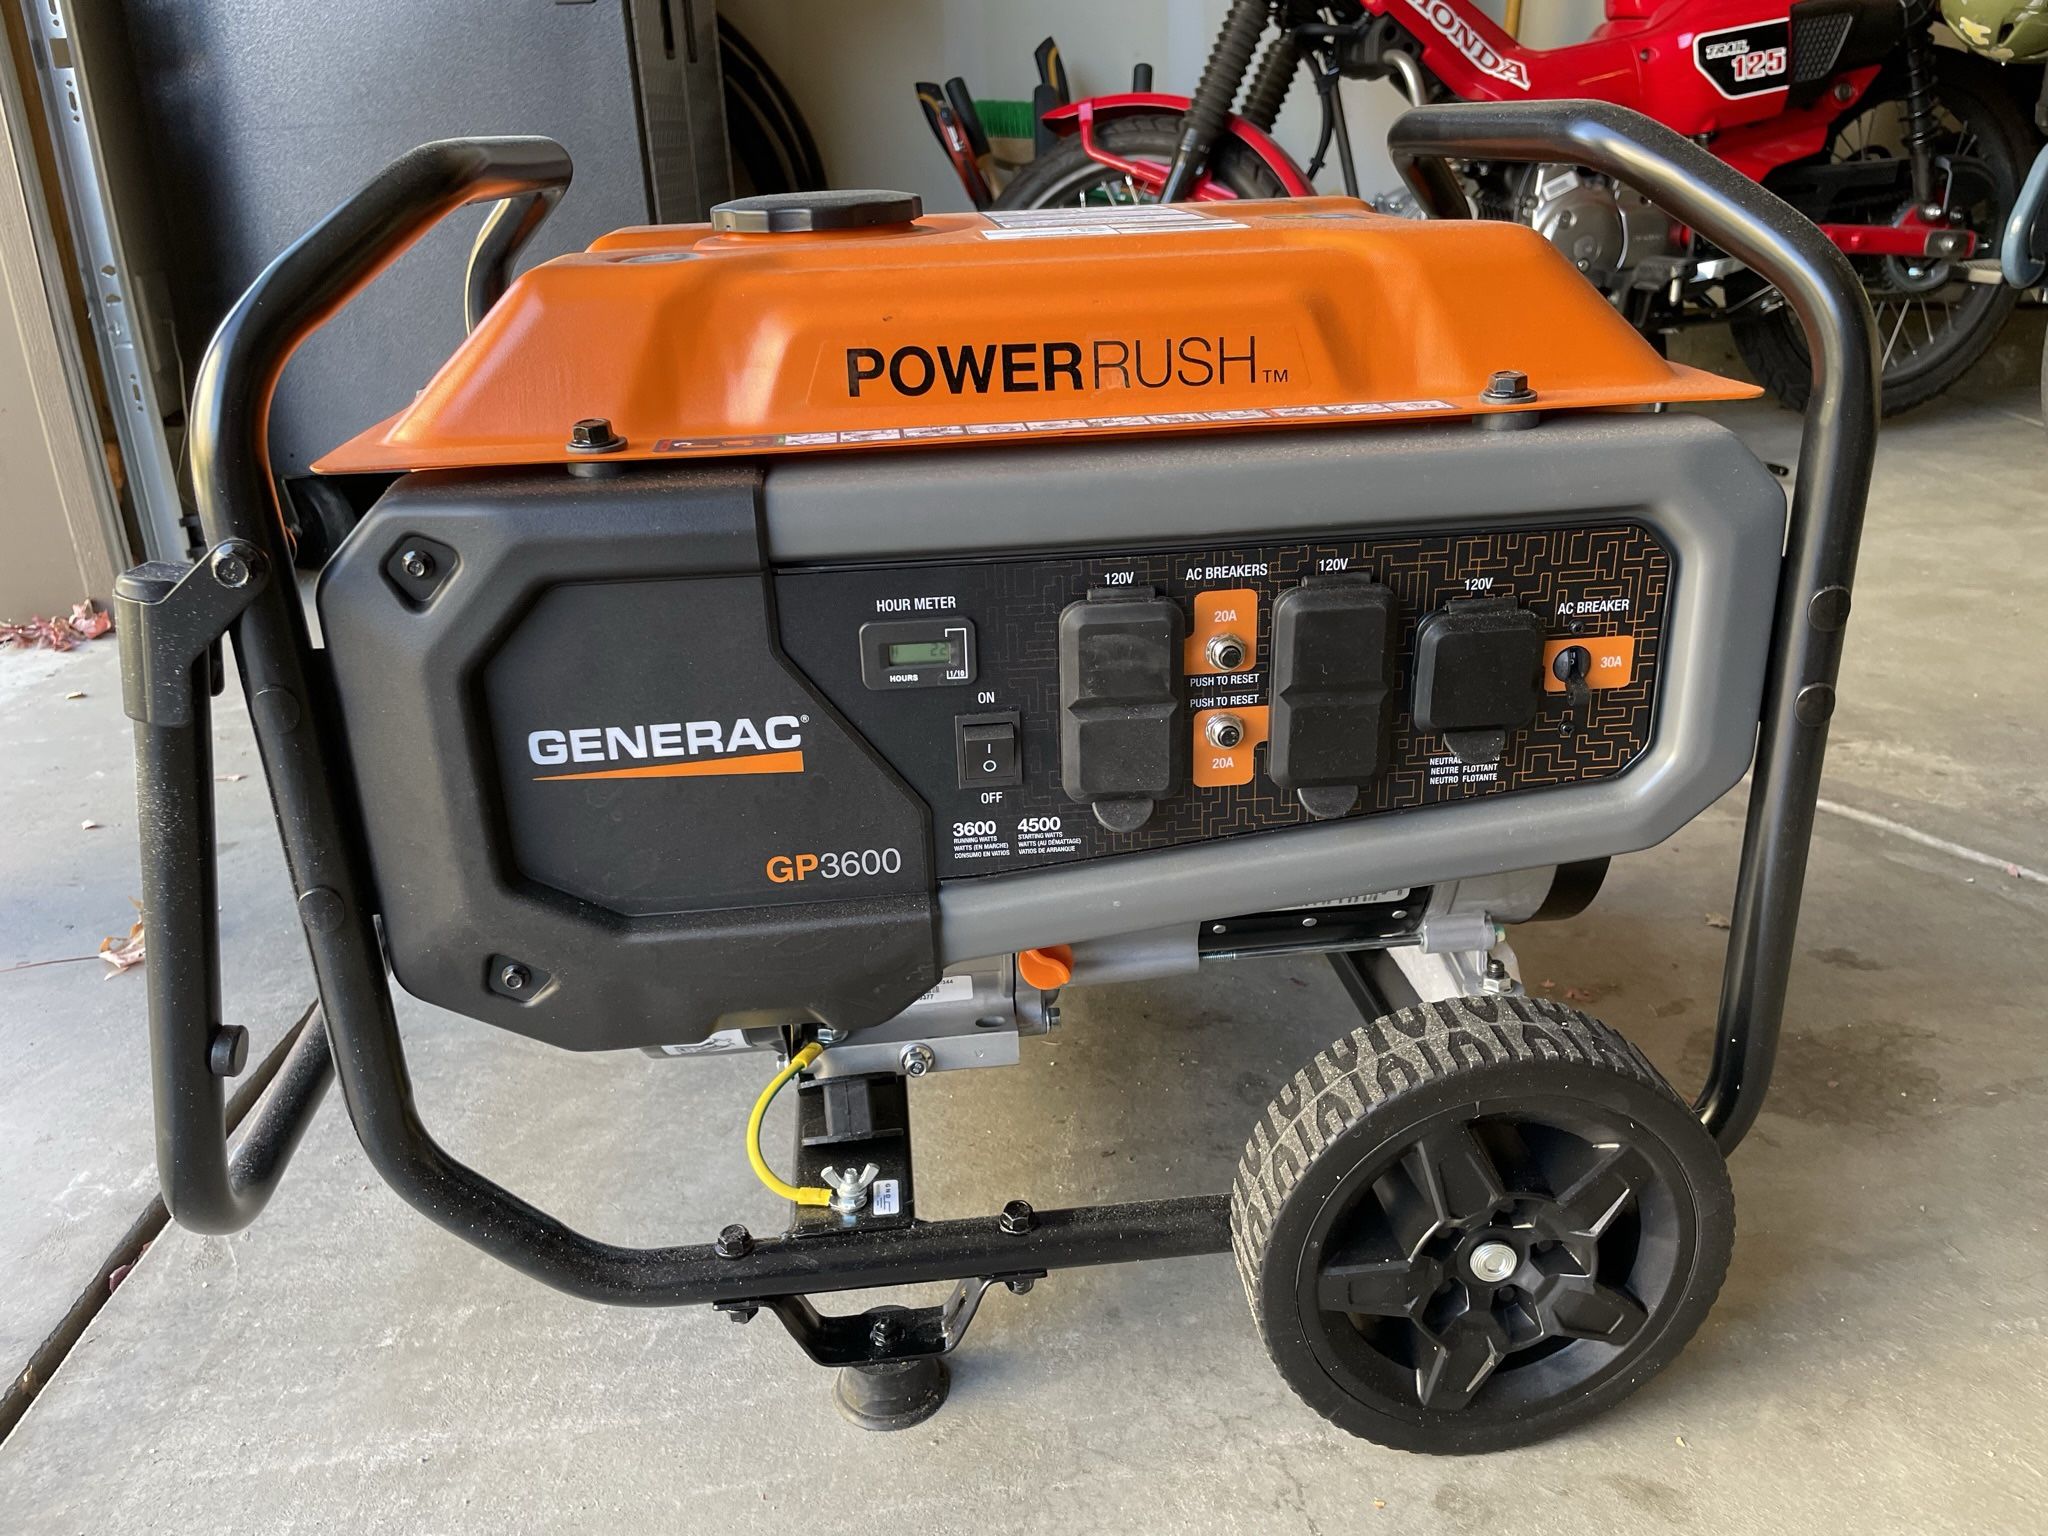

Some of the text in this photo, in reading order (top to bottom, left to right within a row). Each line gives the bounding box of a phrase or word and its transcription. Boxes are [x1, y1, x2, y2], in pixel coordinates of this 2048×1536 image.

[1731, 46, 1787, 82] 125
[1186, 563, 1268, 581] AC BREAKERS
[1318, 558, 1349, 572] 120V
[1104, 571, 1135, 585] 120V
[1464, 577, 1494, 591] 120V
[876, 596, 957, 612] HOUR METER
[1557, 599, 1630, 615] AC BREAKER
[1214, 610, 1237, 623] 20A
[1600, 656, 1623, 668] 30A
[889, 673, 919, 683] HOURS
[1190, 673, 1260, 688] PUSH TO RESET
[977, 691, 995, 704] ON
[1189, 694, 1260, 708] PUSH TO RESET
[1212, 757, 1235, 769] 20A
[1429, 756, 1463, 766] NEUTRAL
[1430, 763, 1498, 775] NEUTRE FLOTTANT
[1429, 772, 1498, 785] NEUTRO FLOTANTE
[980, 791, 1003, 804] OFF
[953, 820, 997, 837] 3600
[1017, 816, 1061, 832] 4500
[1017, 832, 1044, 840] STARTING
[766, 847, 902, 883] GP3600
